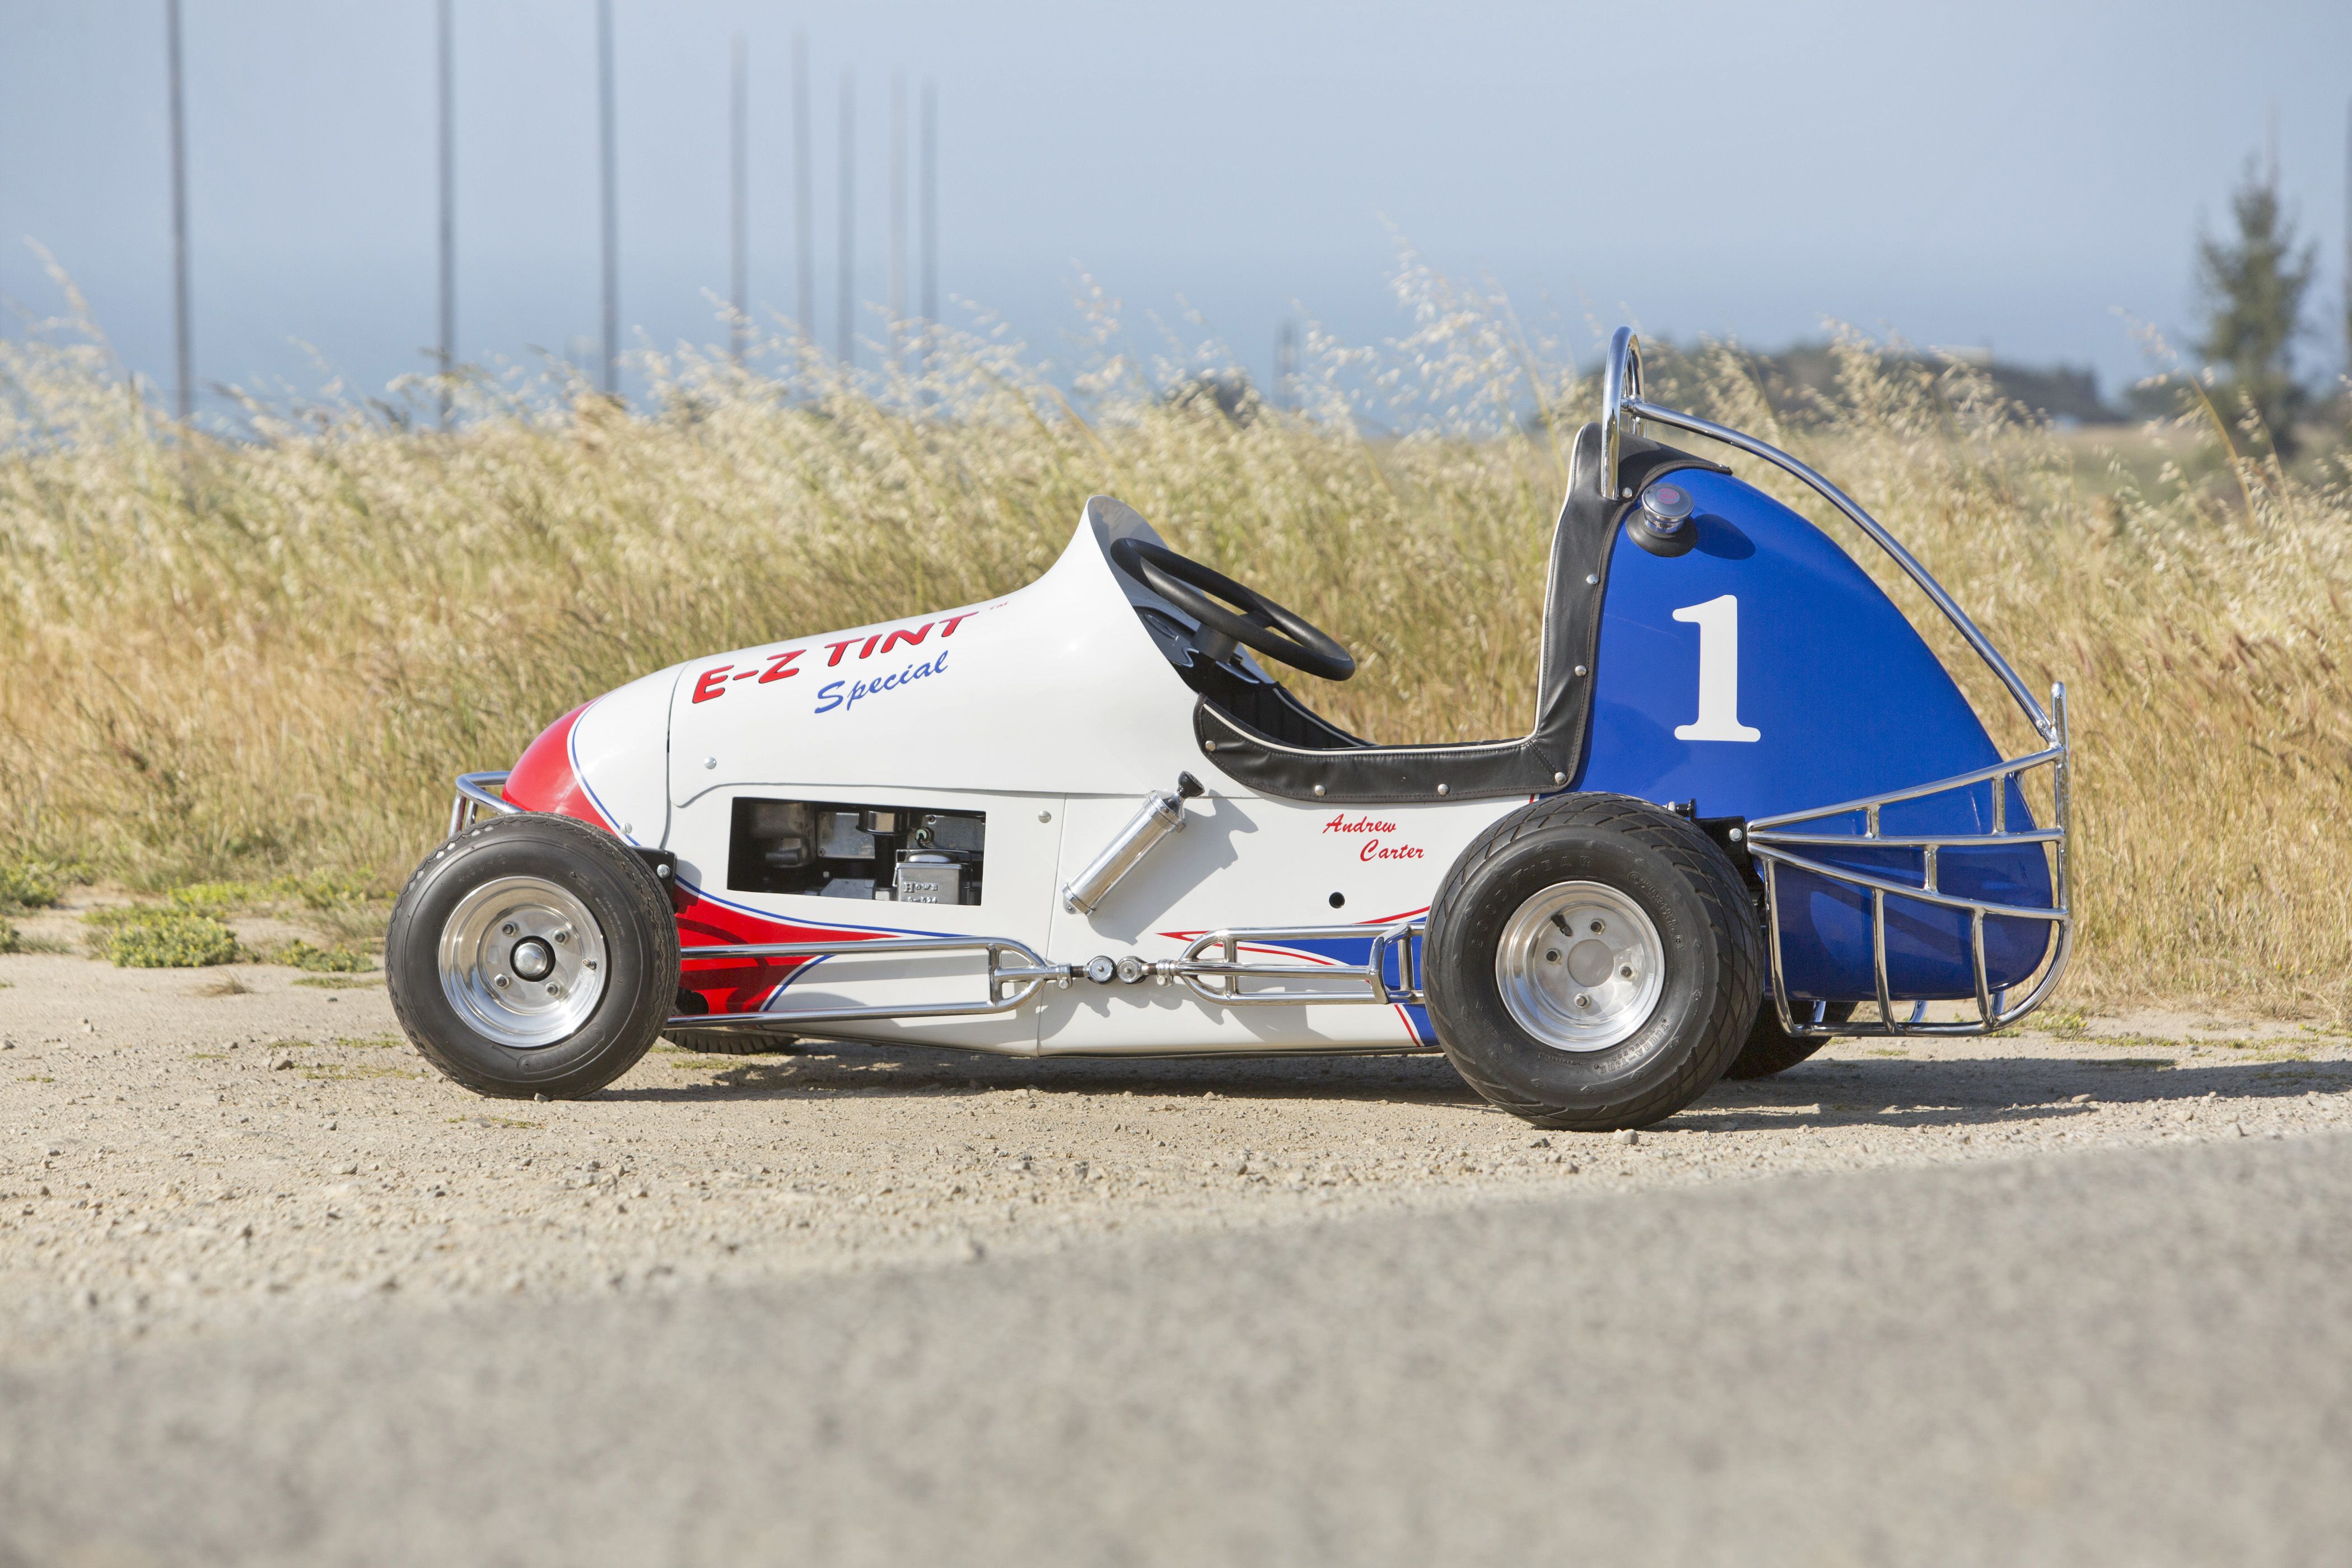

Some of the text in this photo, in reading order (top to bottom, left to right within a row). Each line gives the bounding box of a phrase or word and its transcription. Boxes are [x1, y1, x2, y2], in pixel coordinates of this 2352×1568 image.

[692, 649, 807, 703] E-Z
[824, 611, 979, 666] TINT
[814, 650, 949, 714] Special
[1672, 594, 1761, 743] 1
[1322, 813, 1397, 833] Andrew
[1360, 839, 1424, 862] Carter
